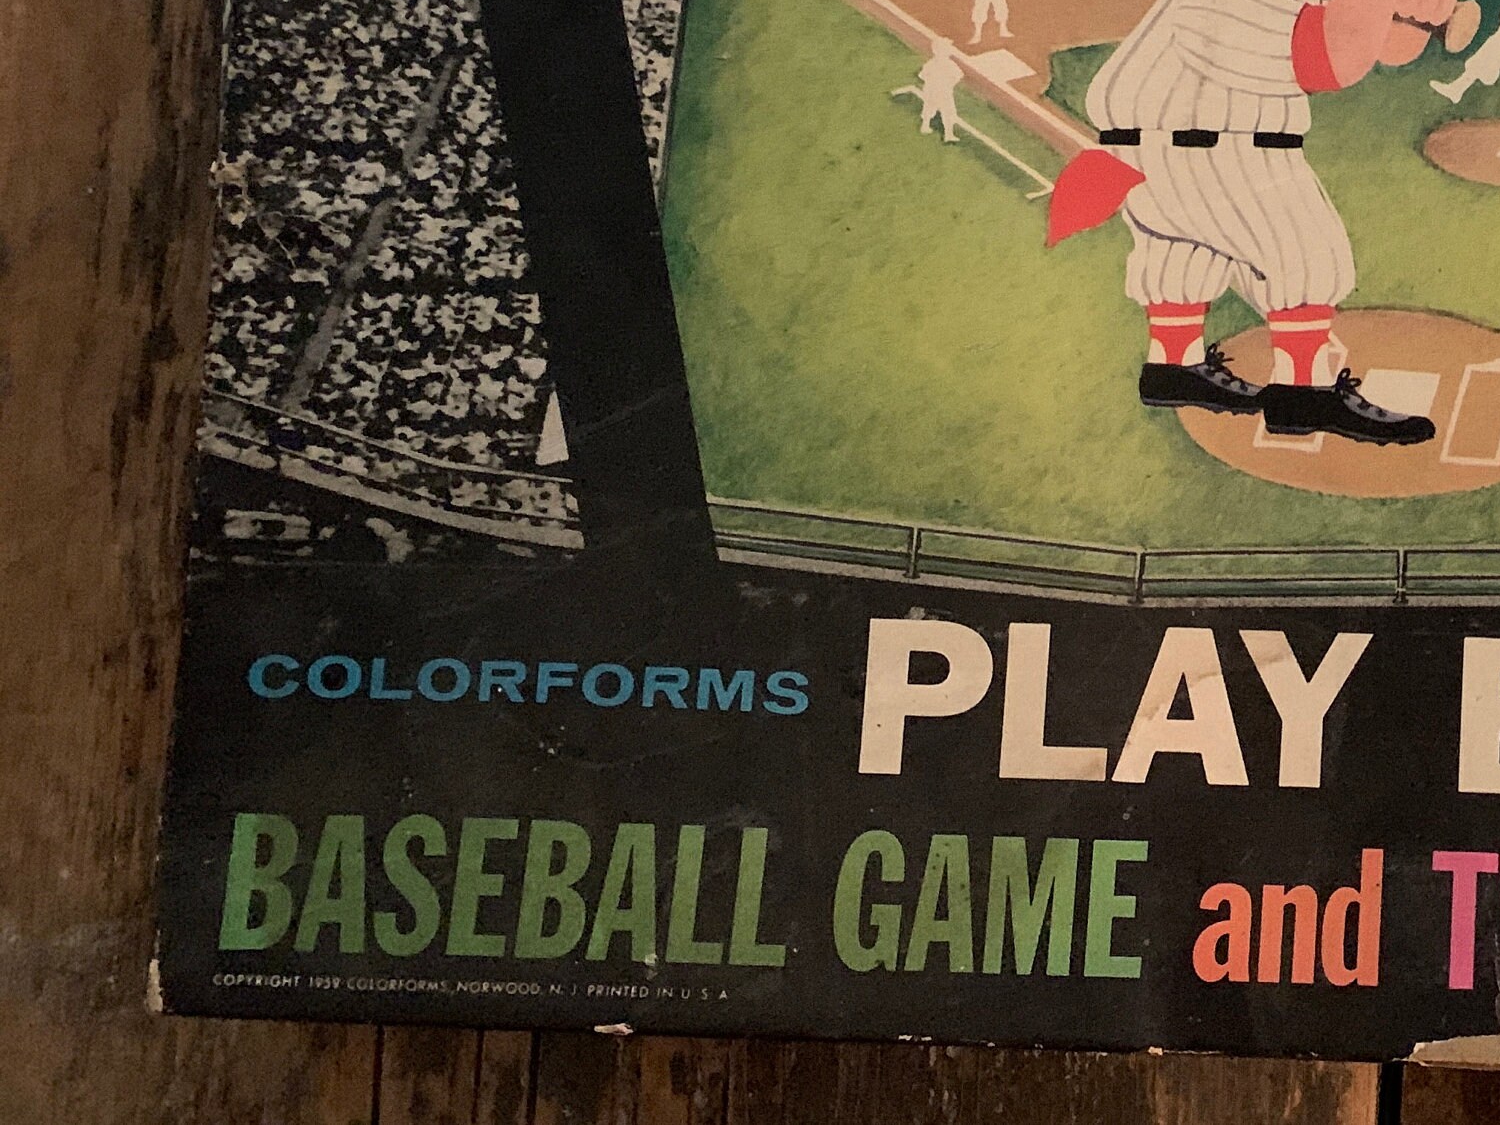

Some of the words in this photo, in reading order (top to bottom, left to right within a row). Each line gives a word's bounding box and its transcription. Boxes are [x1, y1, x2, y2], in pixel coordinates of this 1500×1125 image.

[247, 653, 812, 716] COLORFORMS
[857, 617, 1374, 789] PLAY
[217, 812, 787, 968] BASEBALL
[832, 828, 1150, 979] GAME
[1191, 847, 1384, 987] and
[212, 973, 301, 988] COPYRIGHT
[586, 984, 650, 1000] PRINTED
[655, 986, 675, 999] IN
